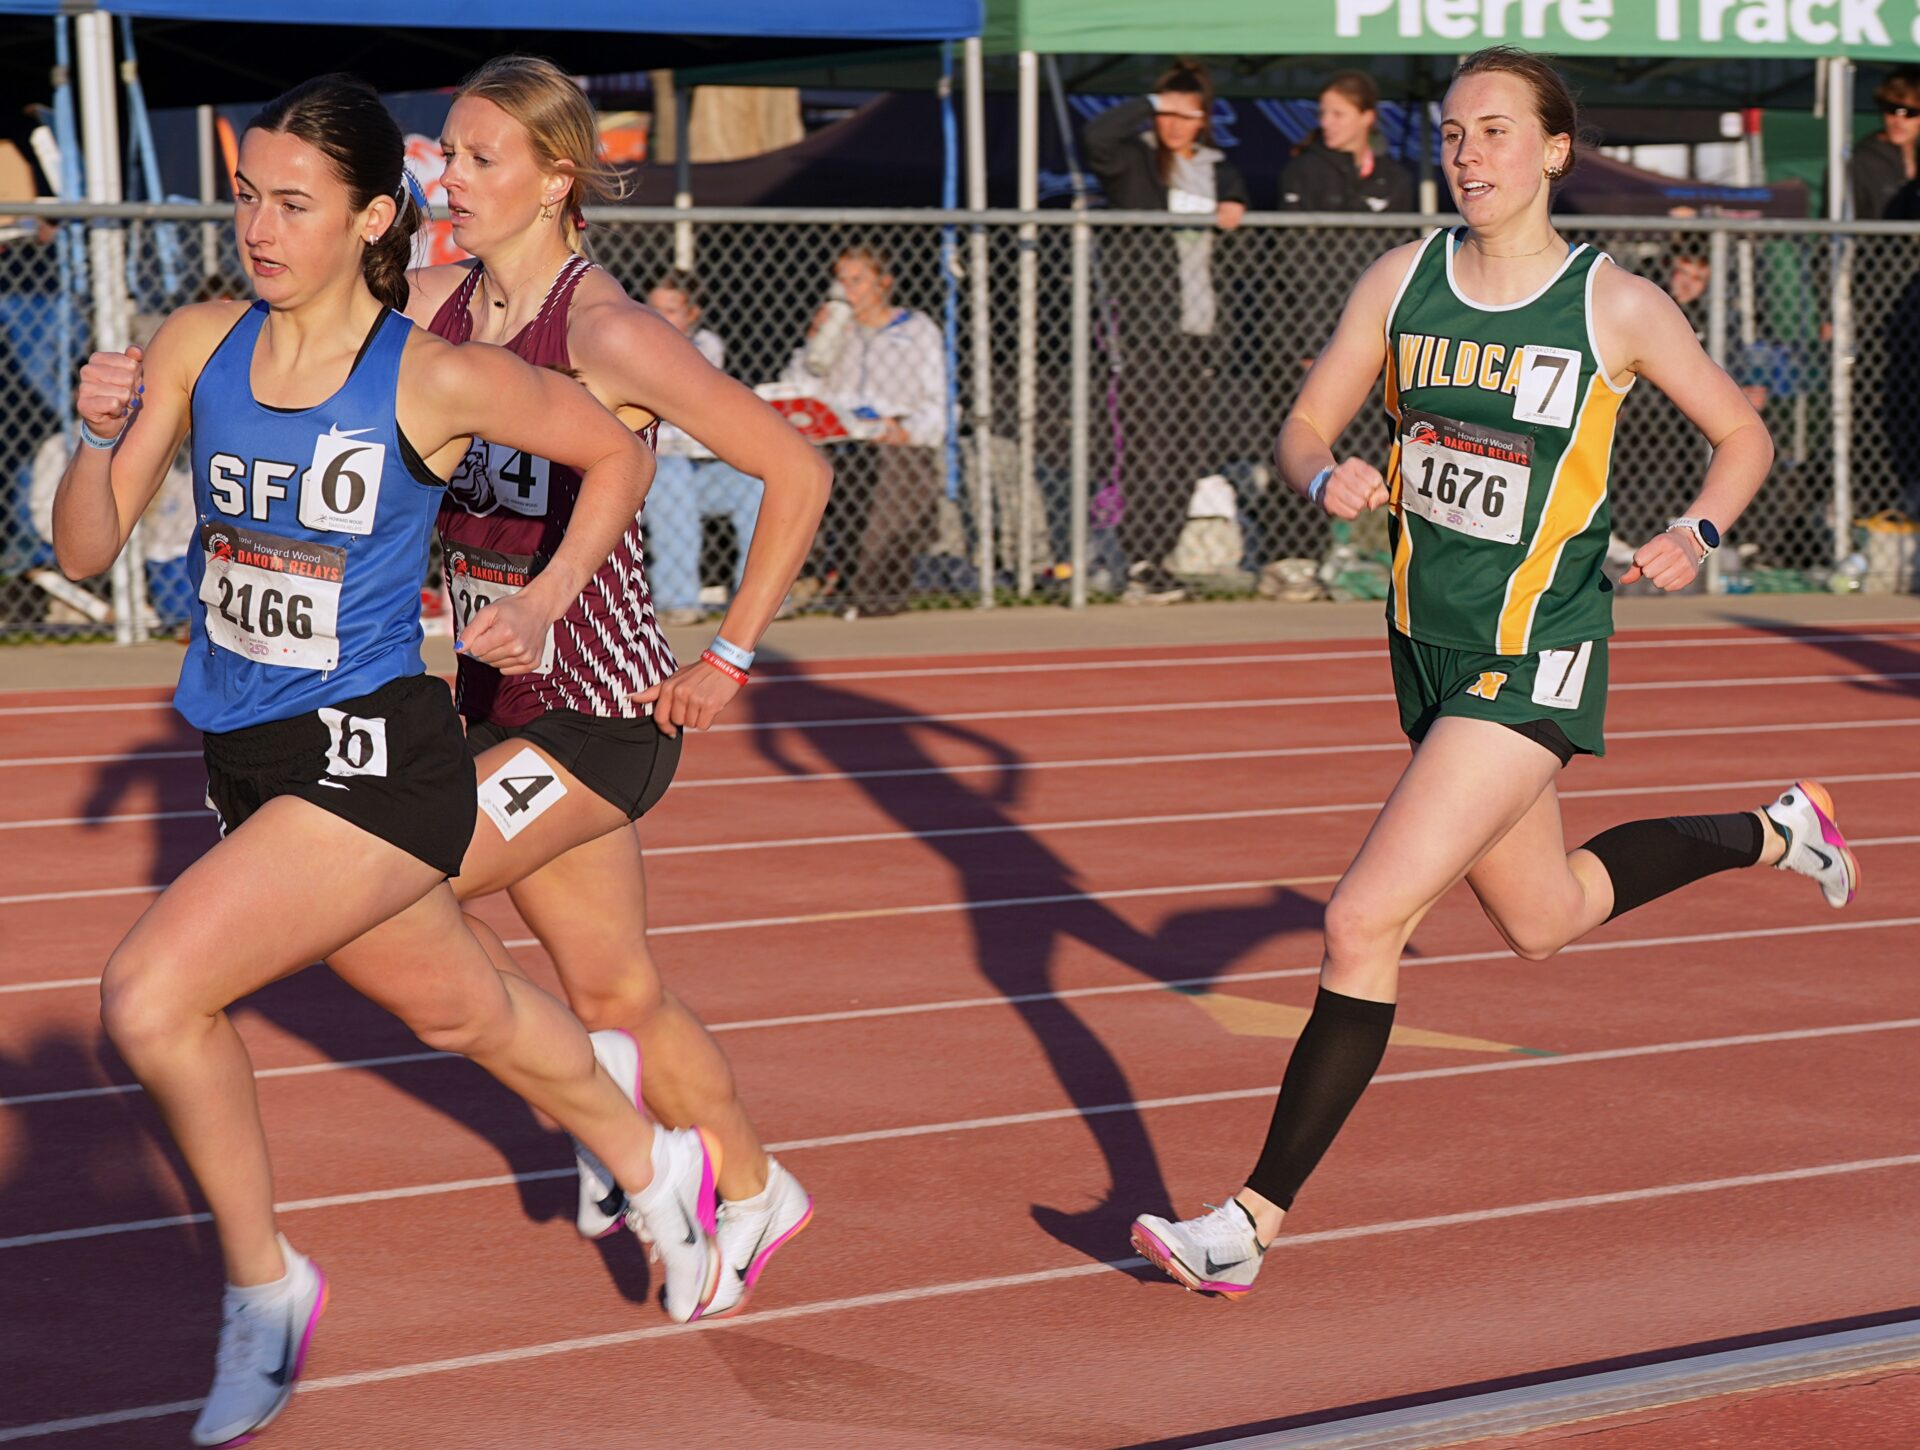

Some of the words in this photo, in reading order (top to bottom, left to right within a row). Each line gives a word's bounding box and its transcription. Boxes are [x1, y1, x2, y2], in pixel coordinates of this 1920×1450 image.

[1531, 354, 1570, 414] 7
[1443, 436, 1484, 456] DAKOTA
[1488, 447, 1528, 466] RELAYS
[1457, 432, 1488, 445] Howard
[1489, 438, 1513, 451] Wood
[208, 451, 330, 533] SF
[321, 447, 373, 515] 6
[499, 449, 537, 499] 4
[1418, 456, 1508, 518] 1676
[238, 550, 284, 572] DAKOTA
[288, 560, 339, 581] RELAYS
[253, 542, 290, 559] Howard
[292, 550, 321, 564] Wood
[471, 565, 504, 583] DAKOTA
[481, 559, 506, 571] Howard
[507, 564, 528, 575] Wood
[218, 576, 313, 640] 2166
[1465, 671, 1508, 701] N
[1550, 642, 1583, 697] 7
[337, 714, 374, 769] 6
[499, 775, 555, 817] 4
